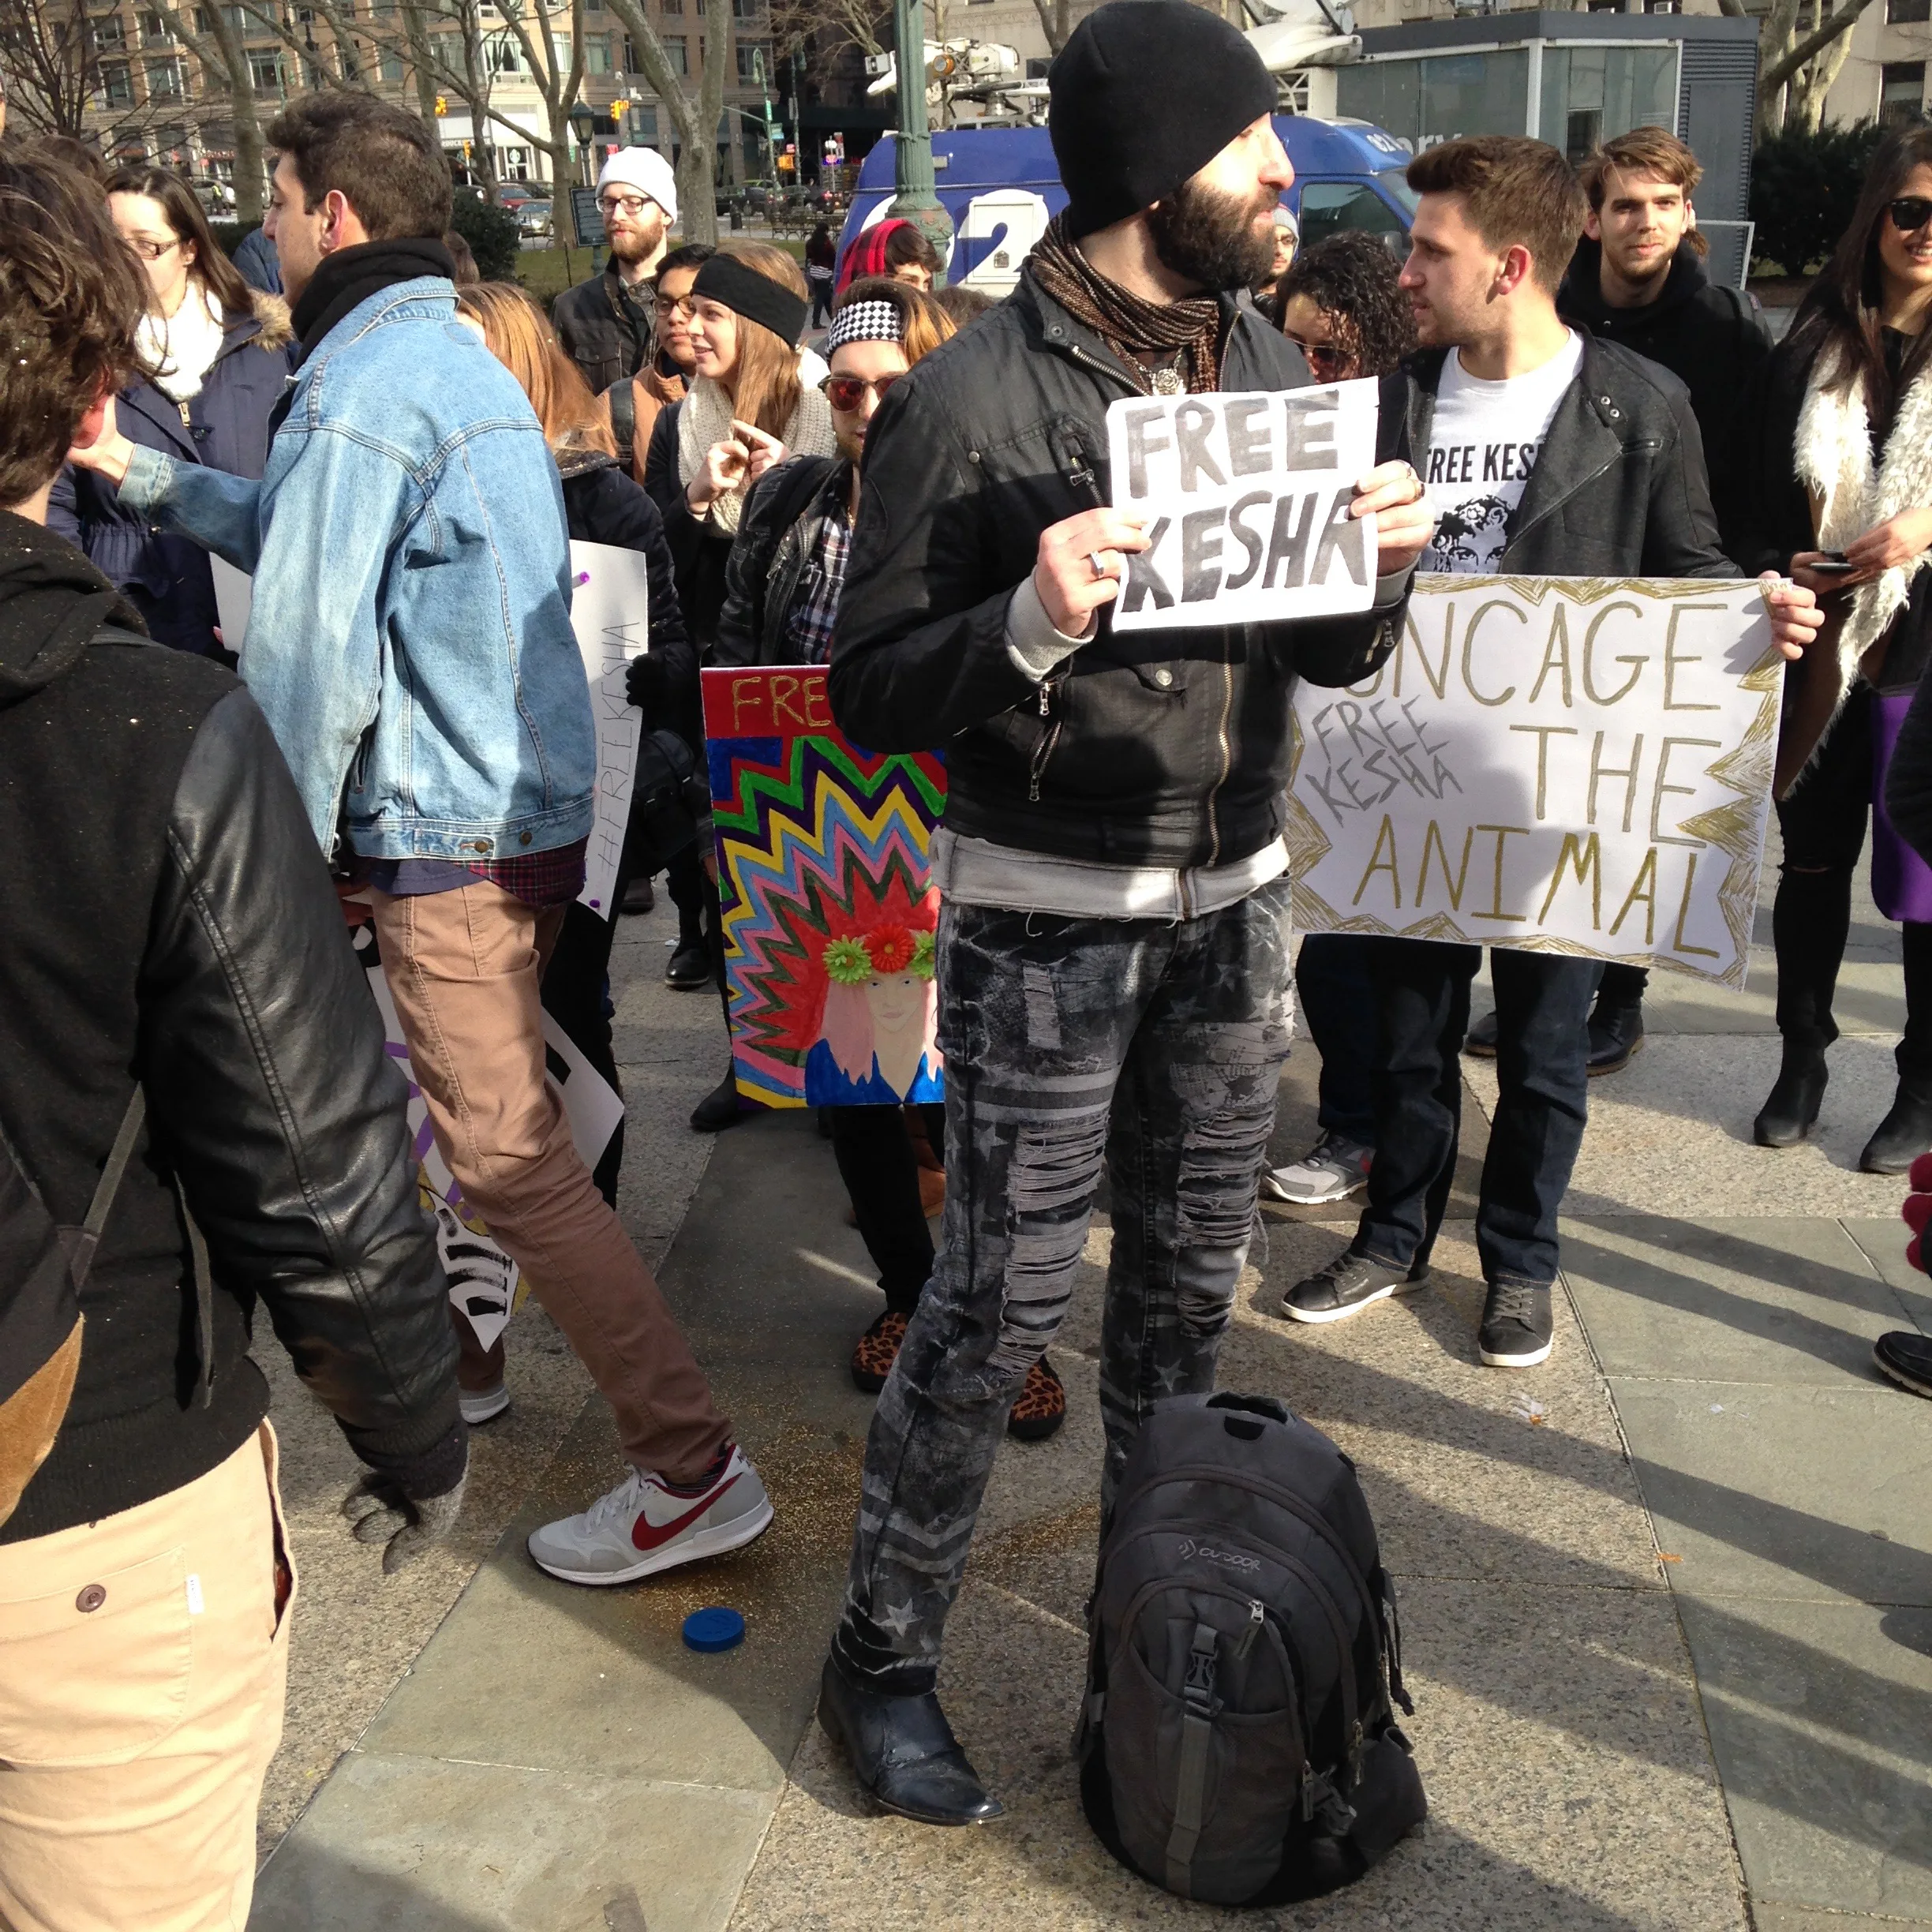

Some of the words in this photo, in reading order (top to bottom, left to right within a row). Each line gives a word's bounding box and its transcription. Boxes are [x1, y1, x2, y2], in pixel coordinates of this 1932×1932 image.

[956, 189, 1049, 298] 2
[1124, 389, 1340, 498] FREE
[1427, 445, 1476, 484] REE
[1483, 443, 1544, 481] KES
[1120, 486, 1368, 612] KESHA
[597, 622, 642, 875] #FREEKESHA
[1312, 694, 1451, 764] FREE
[1305, 749, 1464, 829] KESHA
[1509, 724, 1722, 848] THE
[1352, 814, 1720, 959] ANIMAL
